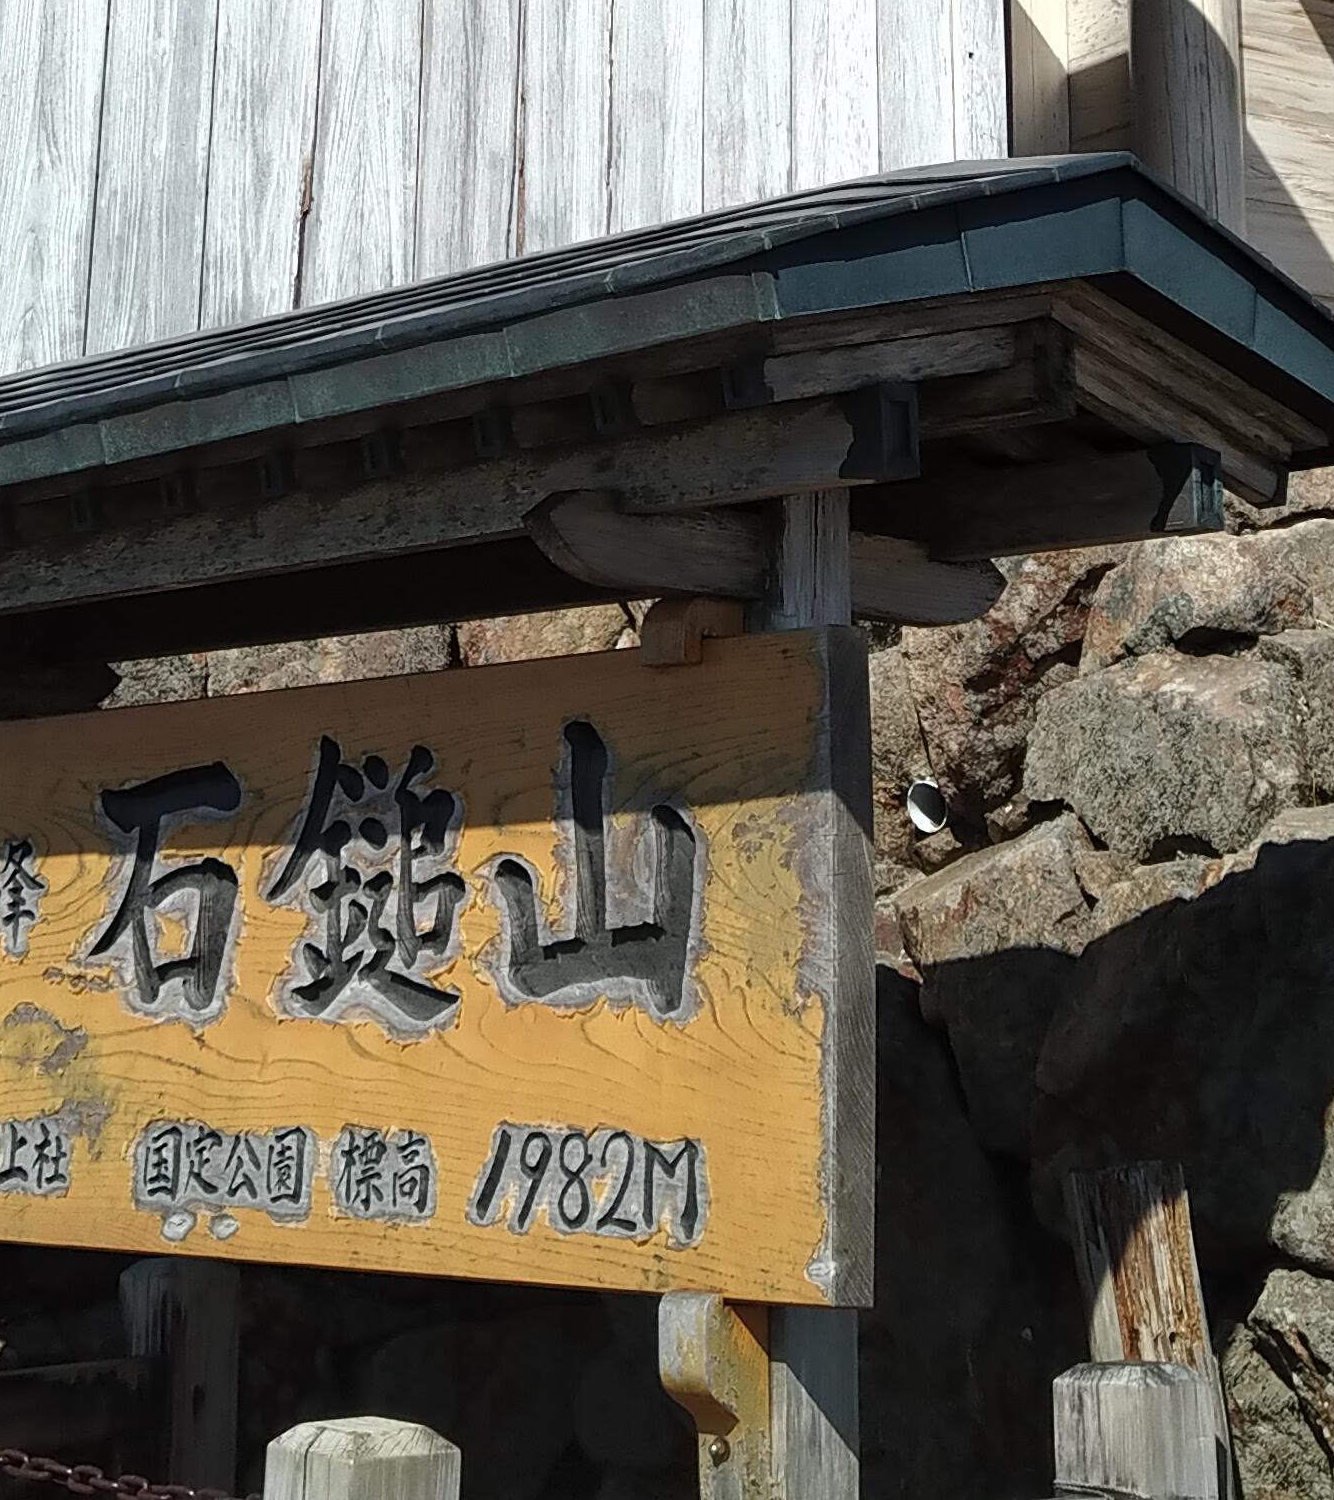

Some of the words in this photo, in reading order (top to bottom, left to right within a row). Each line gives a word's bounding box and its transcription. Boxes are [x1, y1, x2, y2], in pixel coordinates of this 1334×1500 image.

[87, 720, 696, 1015] 石鎚山
[143, 1125, 307, 1204] 国定公園
[339, 1129, 432, 1212] 標高
[476, 1128, 698, 1239] 1982M
